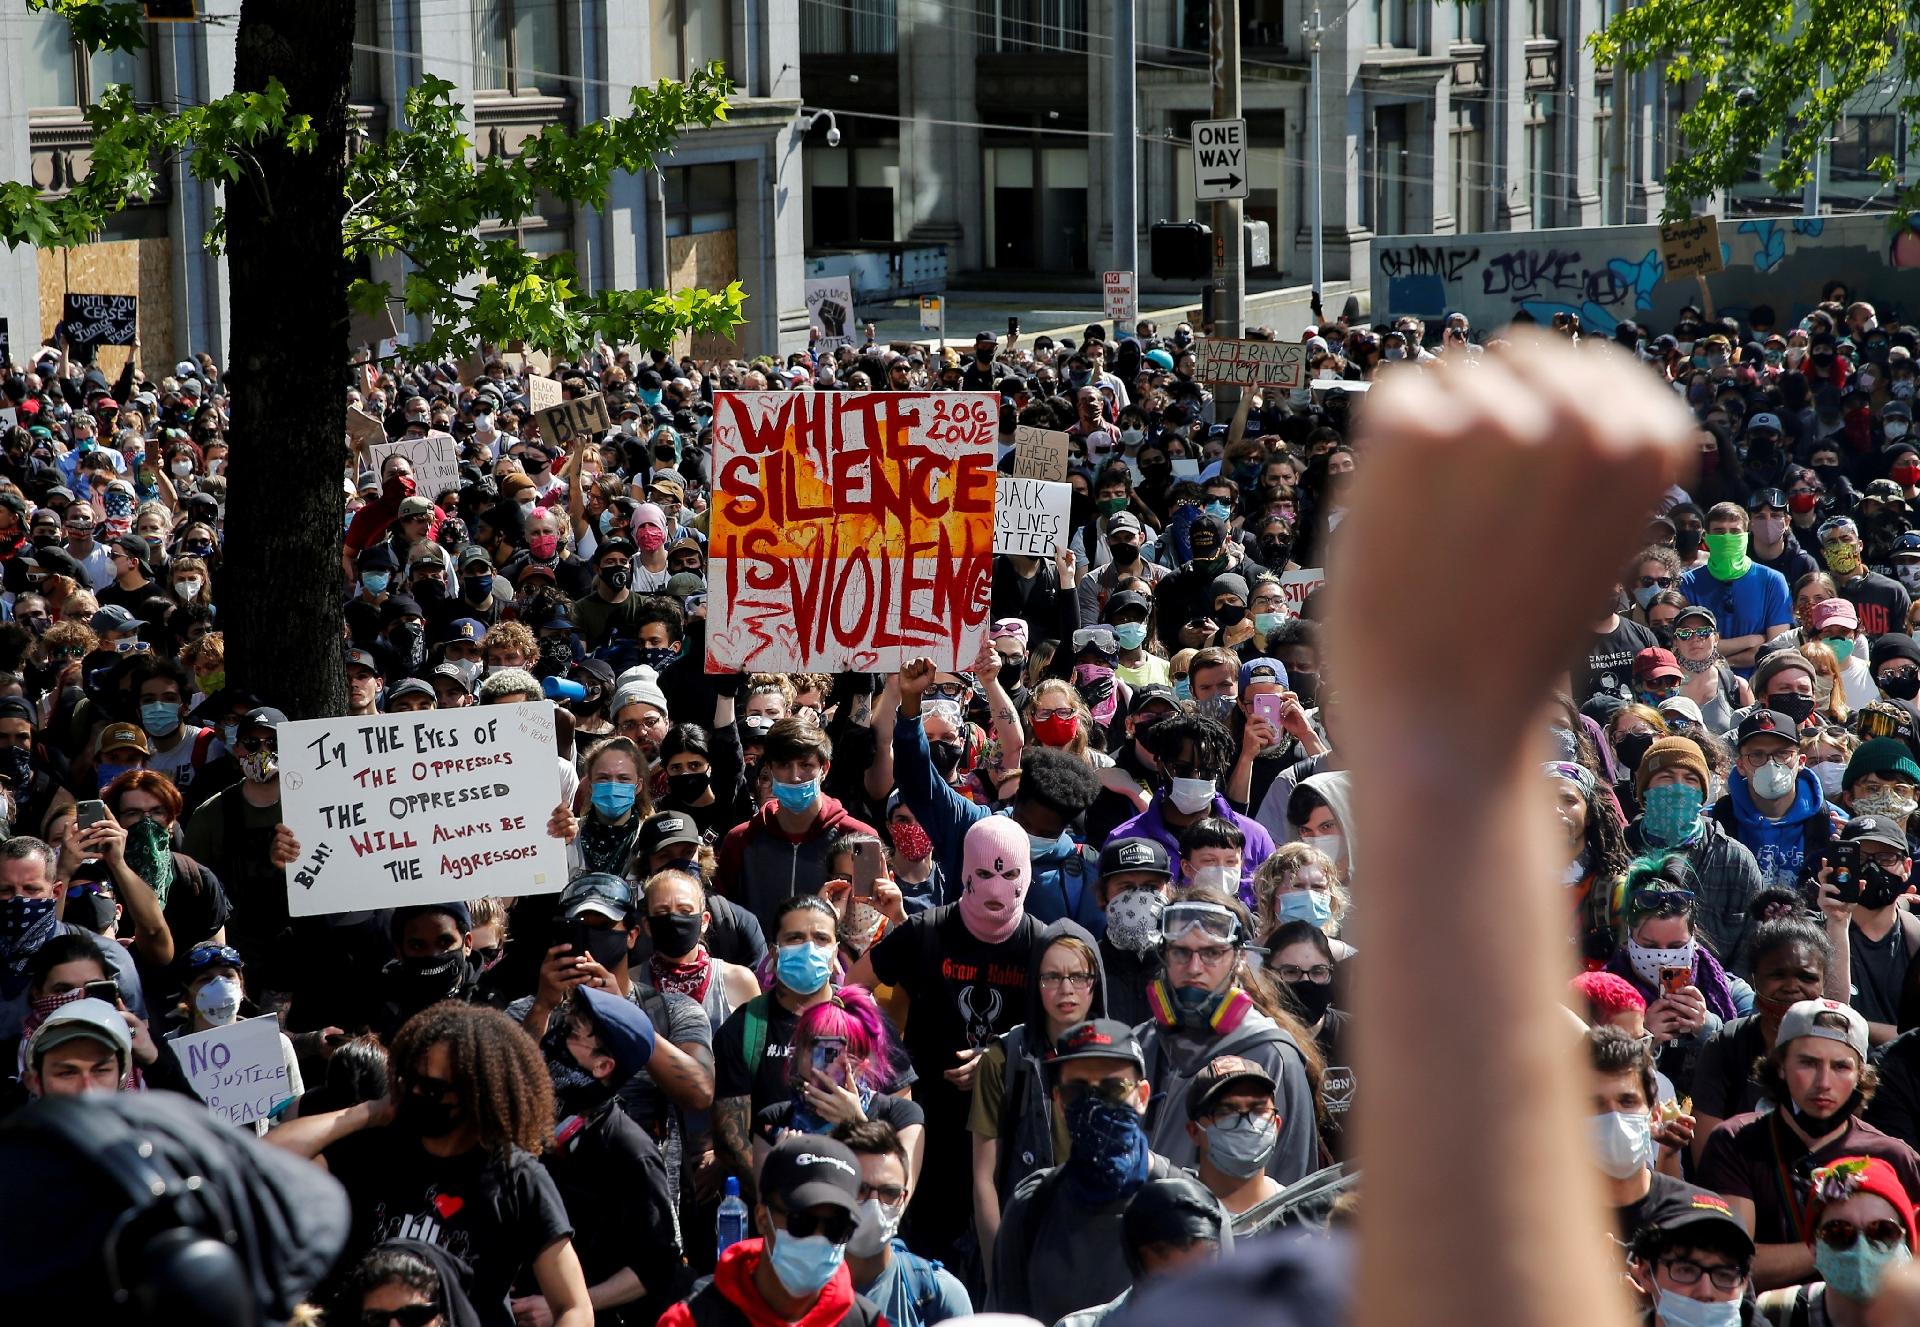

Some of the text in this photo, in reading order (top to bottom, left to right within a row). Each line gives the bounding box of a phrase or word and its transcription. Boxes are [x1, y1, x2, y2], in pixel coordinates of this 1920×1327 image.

[1199, 127, 1240, 145] ONE
[1199, 148, 1241, 167] WAY
[1662, 221, 1708, 243] Enough
[1666, 248, 1711, 271] Enough
[1106, 273, 1119, 283] NO
[71, 296, 136, 310] UNTIL YOU
[68, 318, 113, 342] NO JUSTICE
[105, 321, 136, 344] NO PEACE
[532, 380, 555, 393] BLACK
[533, 391, 555, 404] LIVES
[546, 397, 612, 446] BLM
[724, 392, 988, 459] WHITE 206
[926, 421, 997, 446] LOVE
[1018, 427, 1047, 446] SAY
[1018, 443, 1059, 463] THEIR
[1014, 459, 1062, 481] NAMES
[719, 447, 994, 527] SILENCE
[1017, 513, 1061, 535] LIVES
[724, 528, 790, 628] IS
[1589, 651, 1632, 662] JAPANESE
[1591, 658, 1633, 670] BREAKFAST
[307, 718, 498, 770] In THE EYES OF
[353, 752, 513, 789] THE OPPRESSORS
[319, 783, 511, 830] THE OPPRESSED
[349, 816, 526, 858] WILL ALWAYS BE
[294, 842, 334, 890] BLM!
[384, 858, 423, 883] THE
[188, 1039, 231, 1079] NO
[210, 1064, 286, 1090] JUSTICE
[1324, 1079, 1350, 1090] CGN
[796, 1153, 856, 1176] Champion
